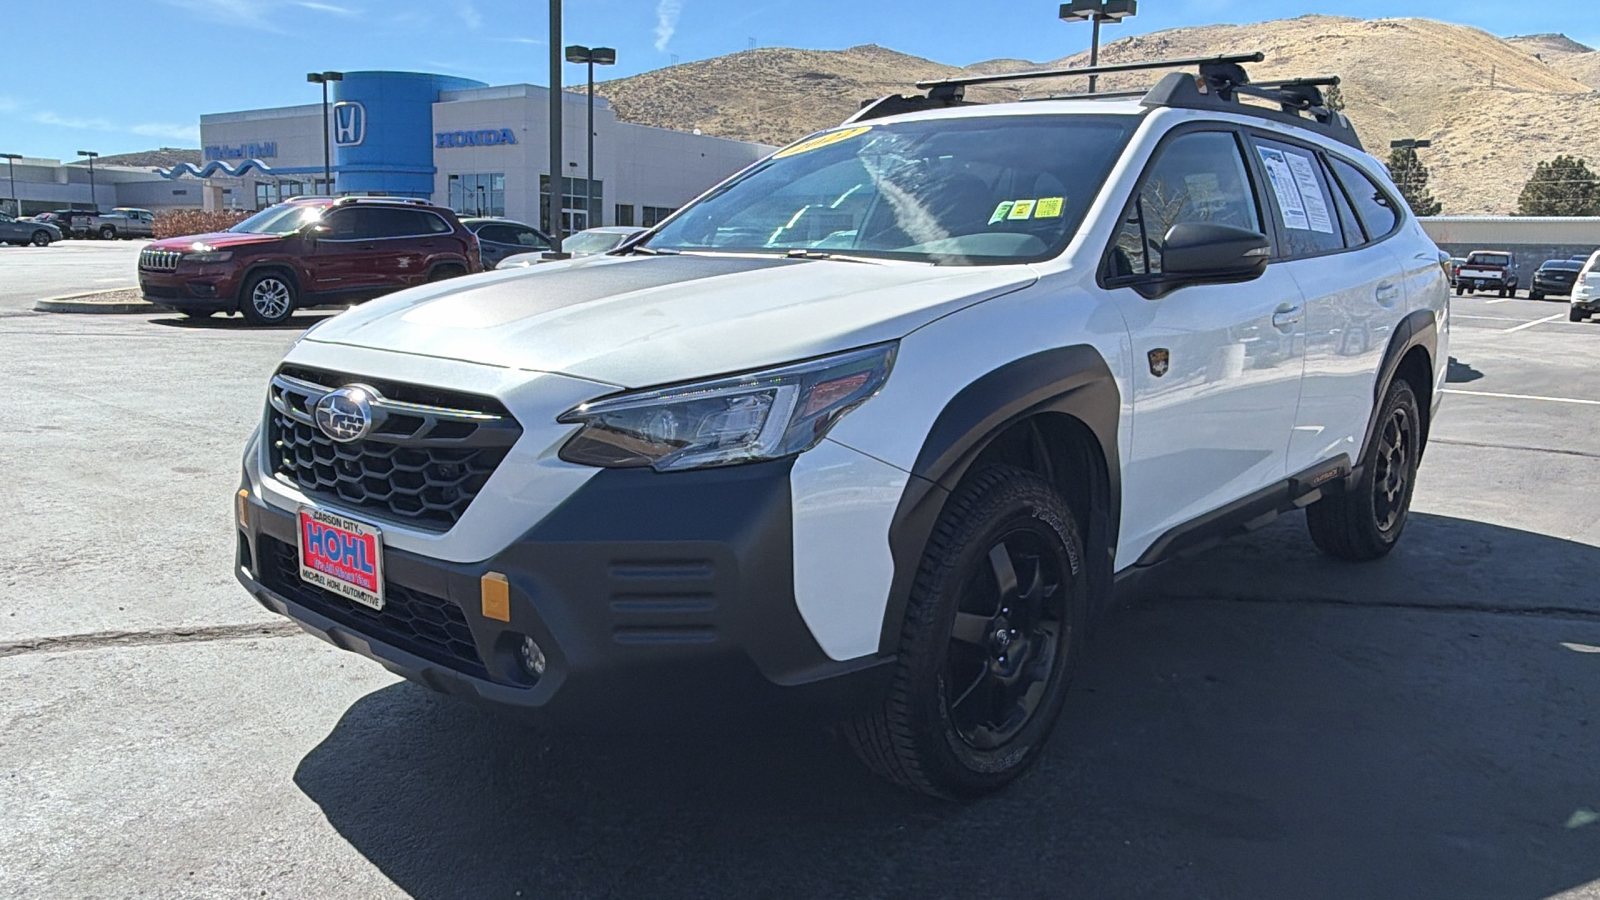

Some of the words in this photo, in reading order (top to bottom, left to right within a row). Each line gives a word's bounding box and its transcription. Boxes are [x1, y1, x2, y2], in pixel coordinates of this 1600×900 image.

[435, 128, 516, 149] HONDA
[313, 511, 341, 527] CARSON
[343, 518, 360, 533] CITY
[306, 521, 374, 575] HOHL
[326, 577, 342, 592] HOHL
